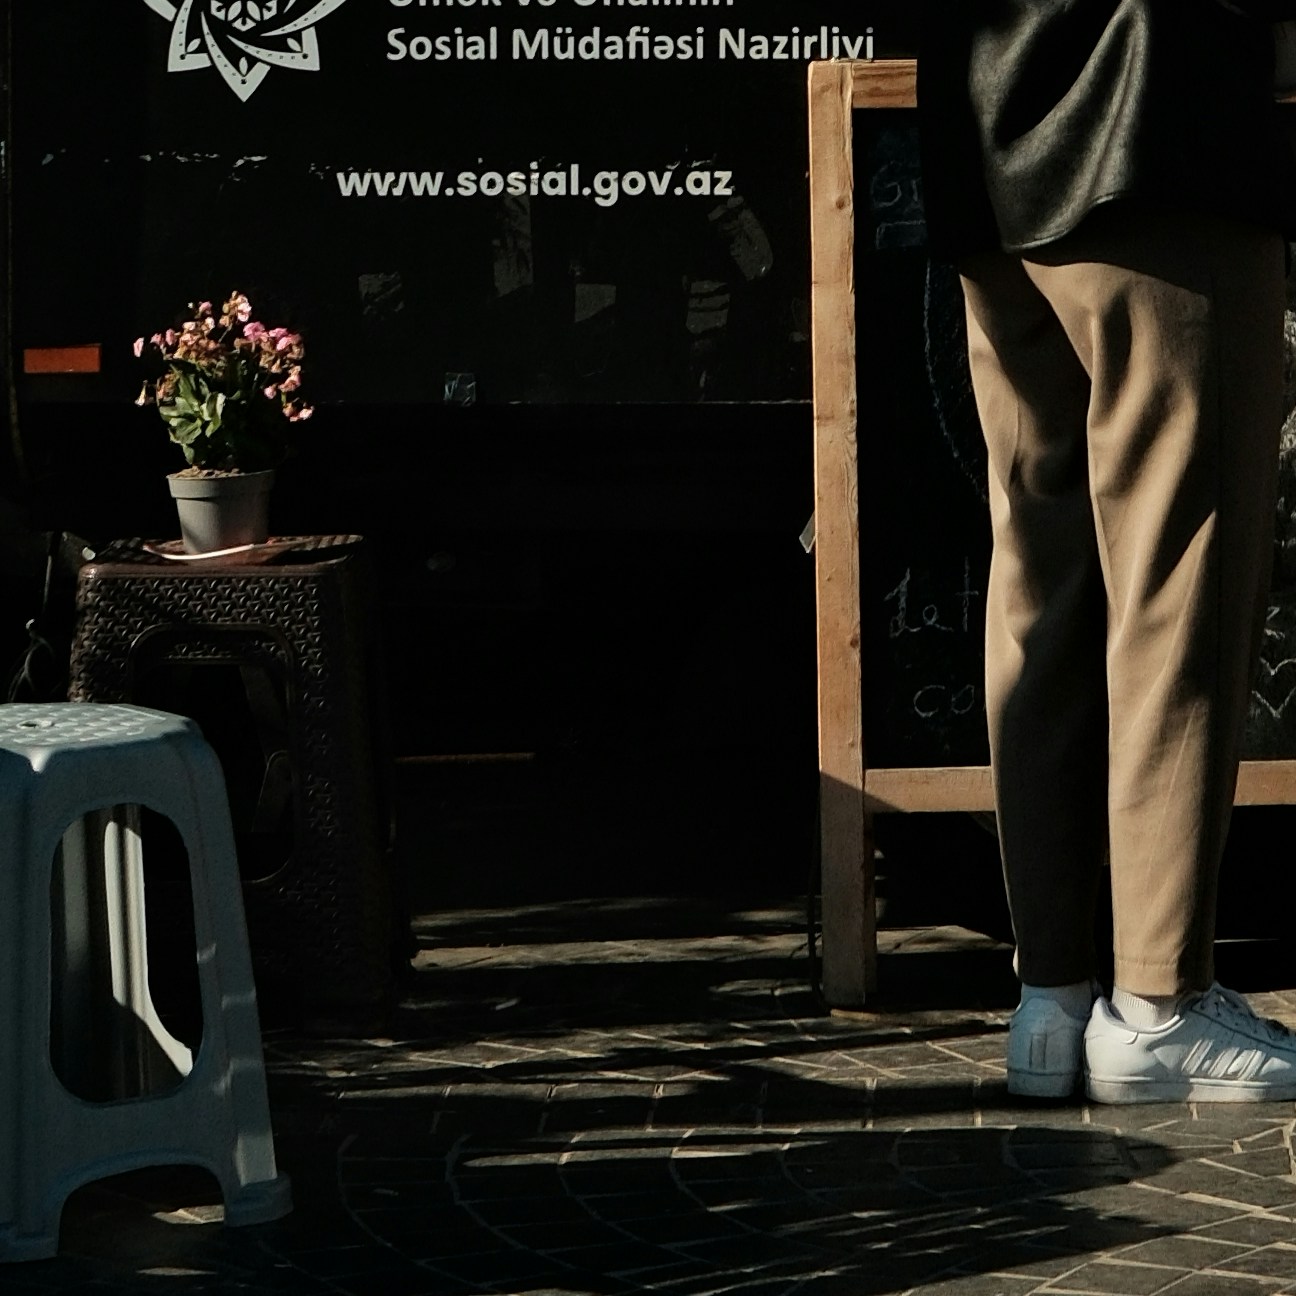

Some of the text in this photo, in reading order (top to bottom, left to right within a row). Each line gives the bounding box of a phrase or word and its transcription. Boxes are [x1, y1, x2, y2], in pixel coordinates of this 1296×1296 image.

[387, 26, 497, 61] Sosial
[512, 25, 704, 61] Müdafiəsi
[336, 163, 734, 207] www.sosial.gov.az
